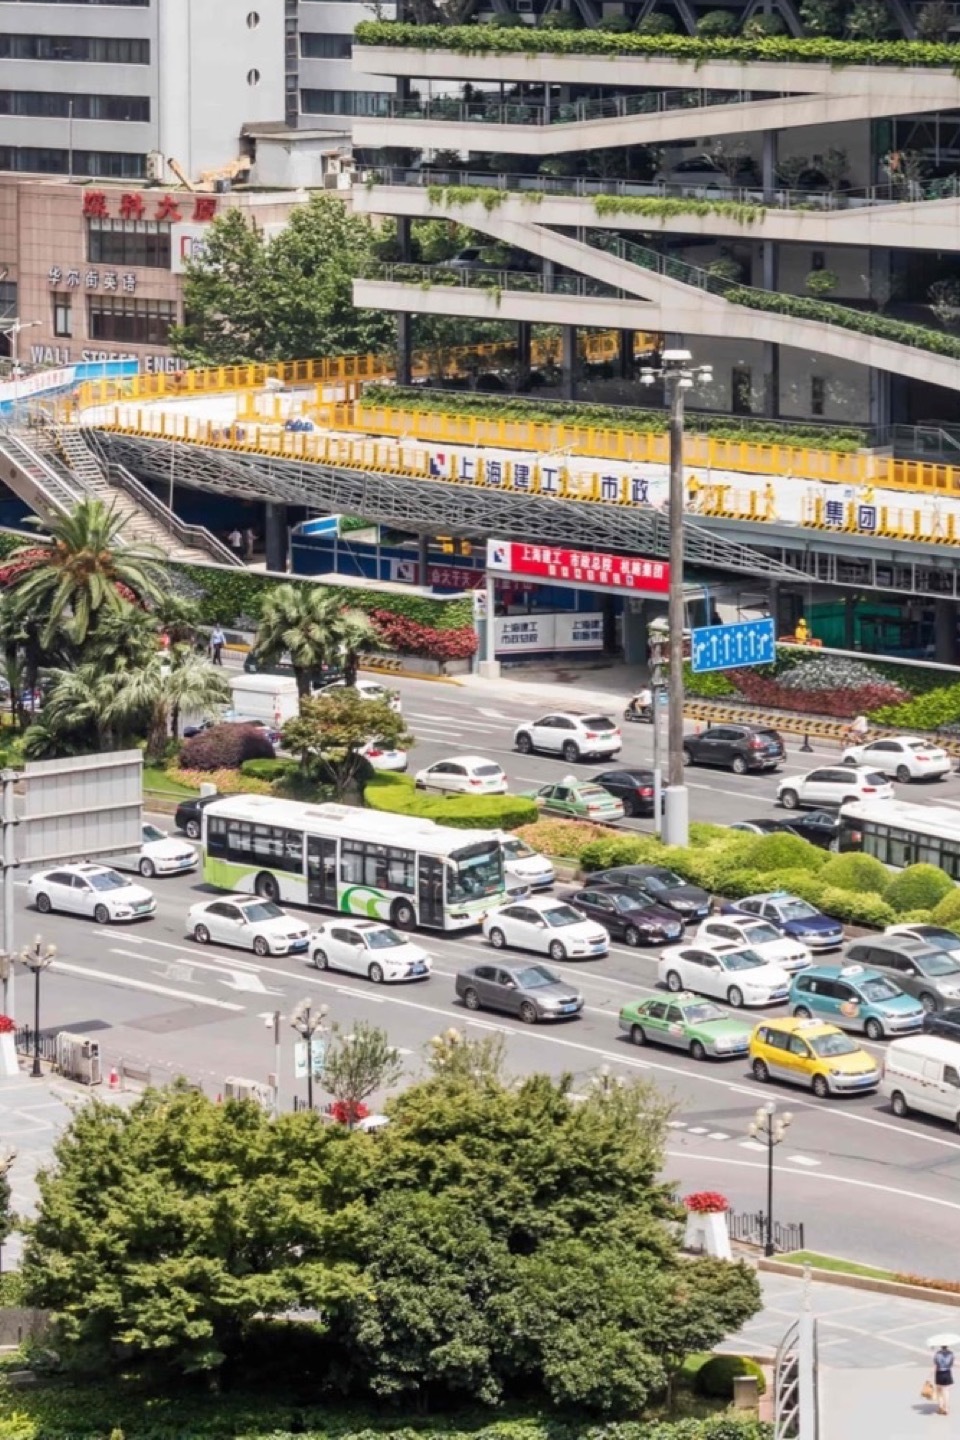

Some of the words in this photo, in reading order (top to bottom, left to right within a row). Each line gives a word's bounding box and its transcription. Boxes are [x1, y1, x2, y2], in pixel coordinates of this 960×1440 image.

[48, 267, 137, 293] 华尔街英语
[458, 456, 559, 493] 上海建工
[601, 475, 649, 504] 市政
[825, 500, 876, 531] 集团
